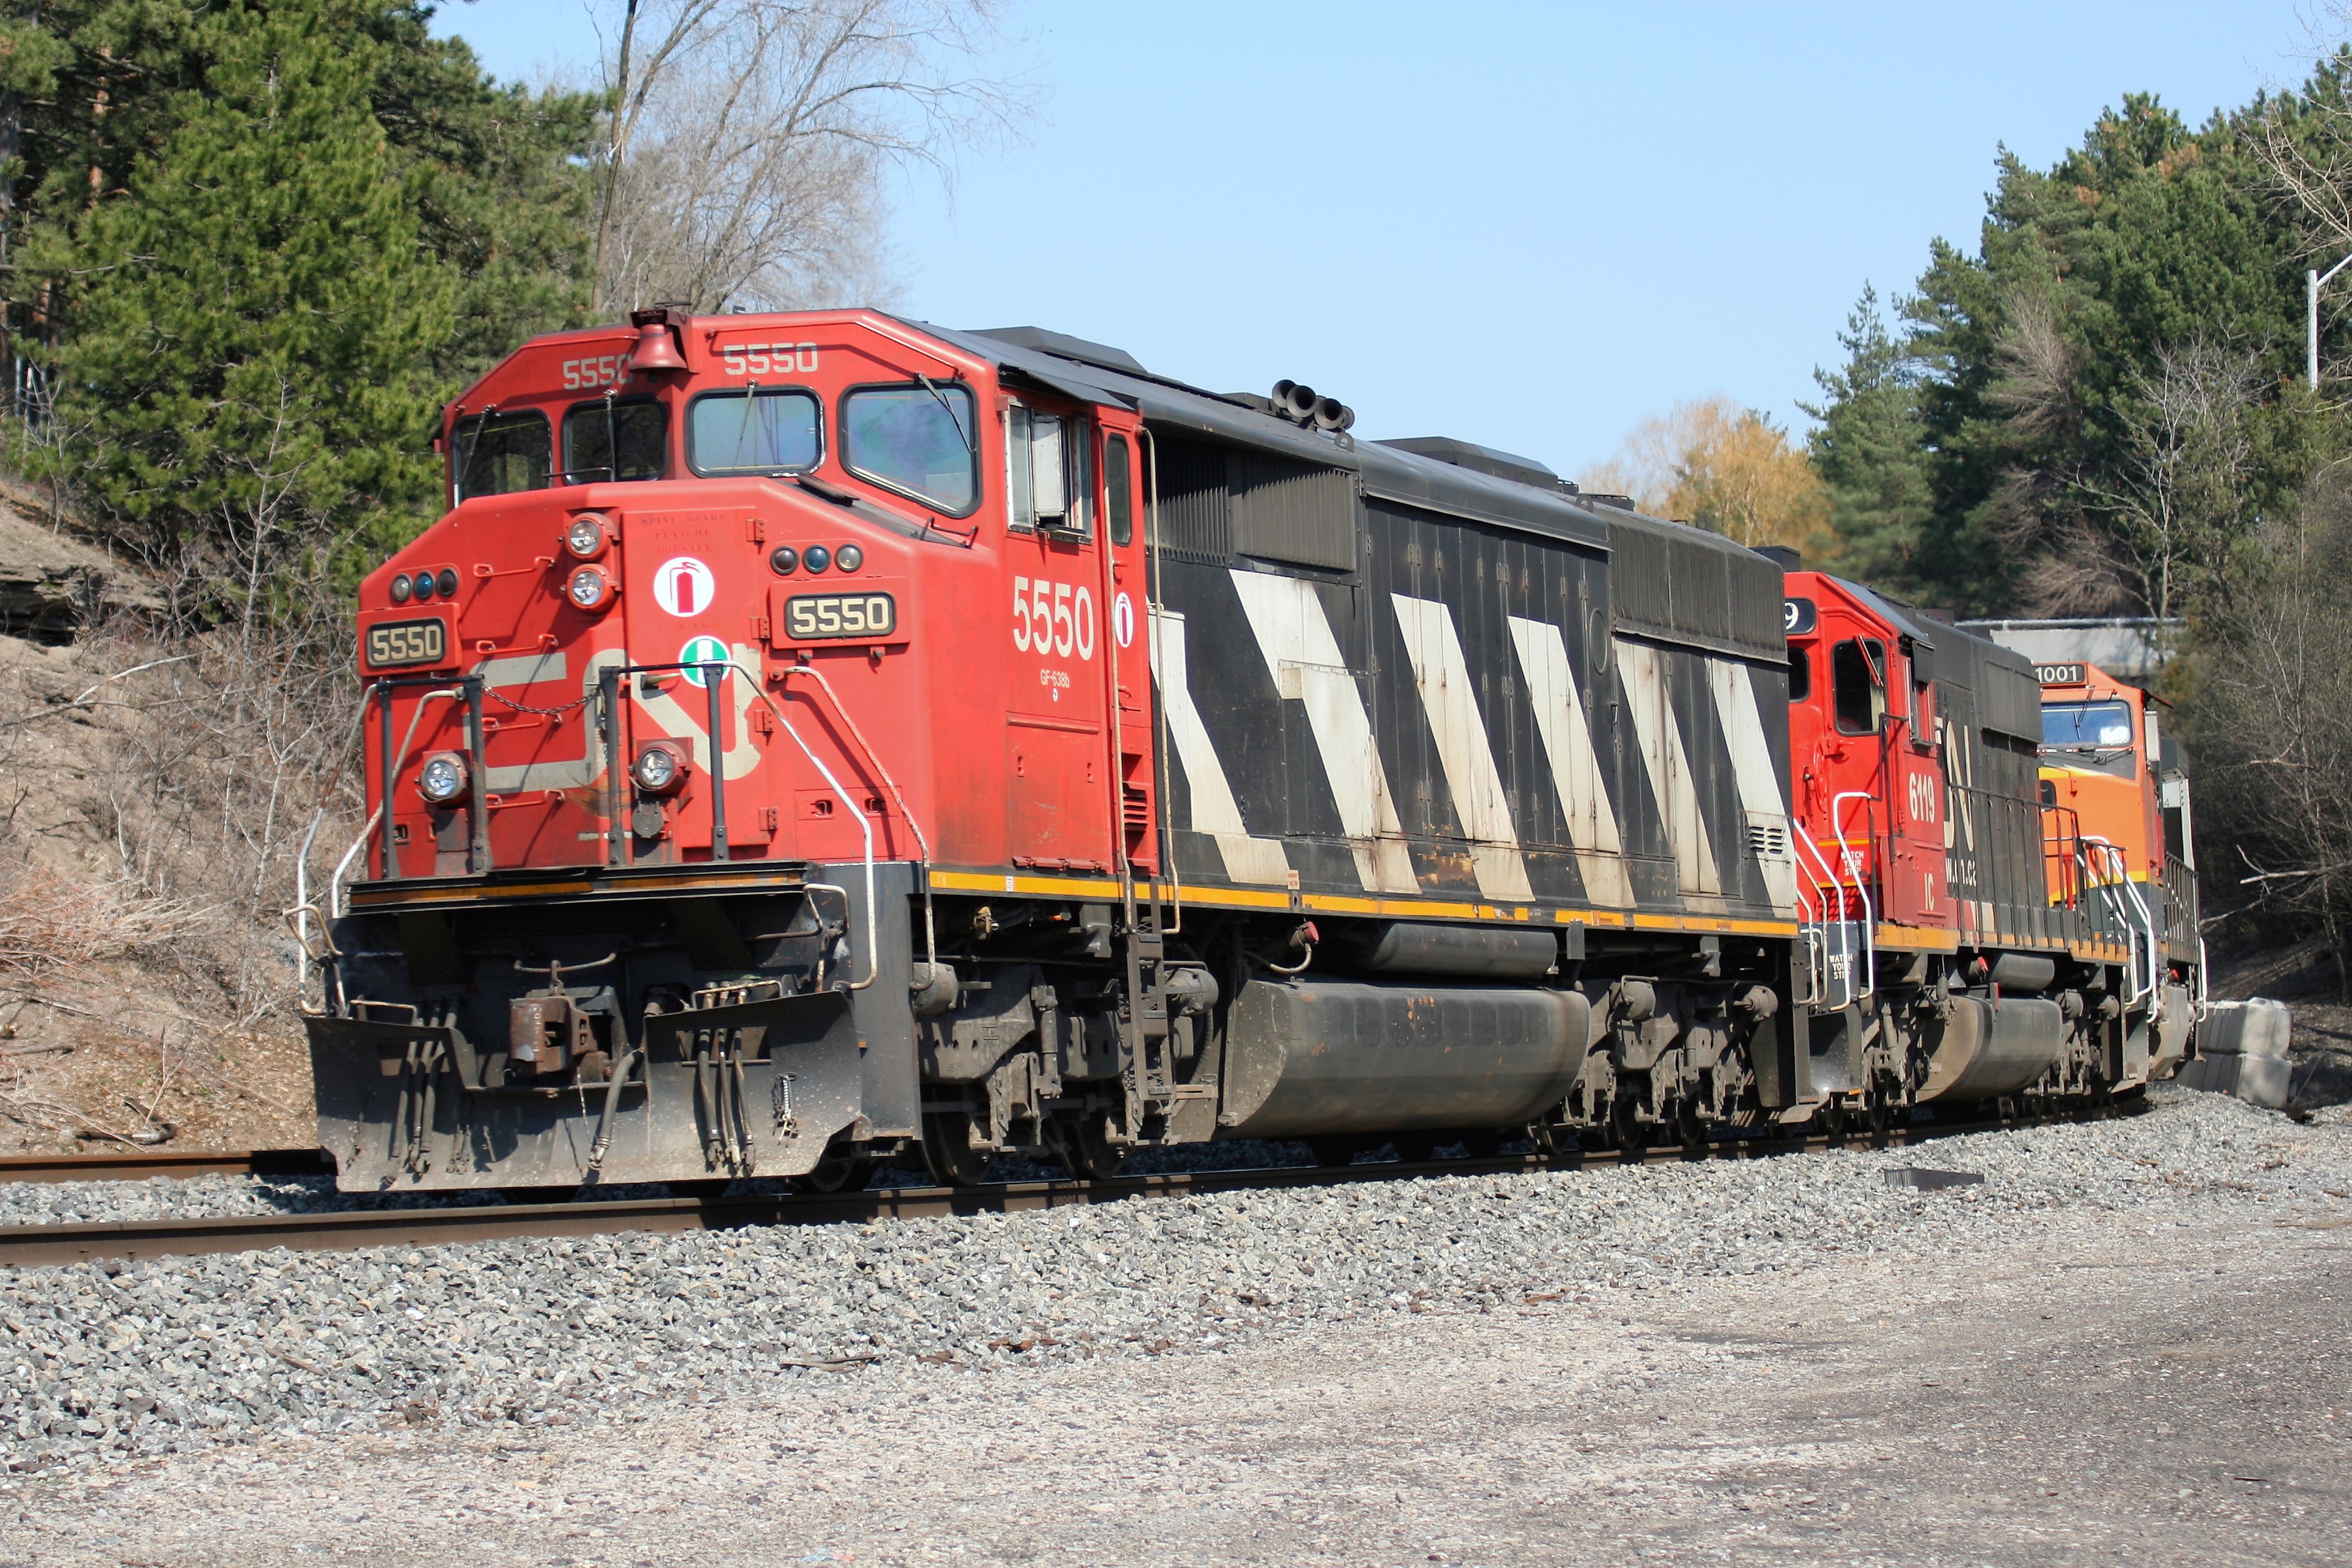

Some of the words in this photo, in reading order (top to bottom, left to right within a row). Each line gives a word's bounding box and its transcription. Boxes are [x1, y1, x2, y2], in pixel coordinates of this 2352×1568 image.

[562, 353, 634, 391] 5550
[723, 342, 818, 376] 5550
[792, 596, 890, 634] 5550
[1013, 575, 1095, 662] 5550
[372, 624, 442, 662] 5550
[1039, 668, 1071, 689] GF-638b
[2034, 665, 2078, 683] 1001
[1908, 771, 1936, 824] 6119
[1840, 850, 1865, 860] WTCH
[1843, 859, 1862, 868] YUR
[1844, 867, 1862, 877] STP
[1923, 872, 1935, 912] IC
[1829, 953, 1854, 963] WATH
